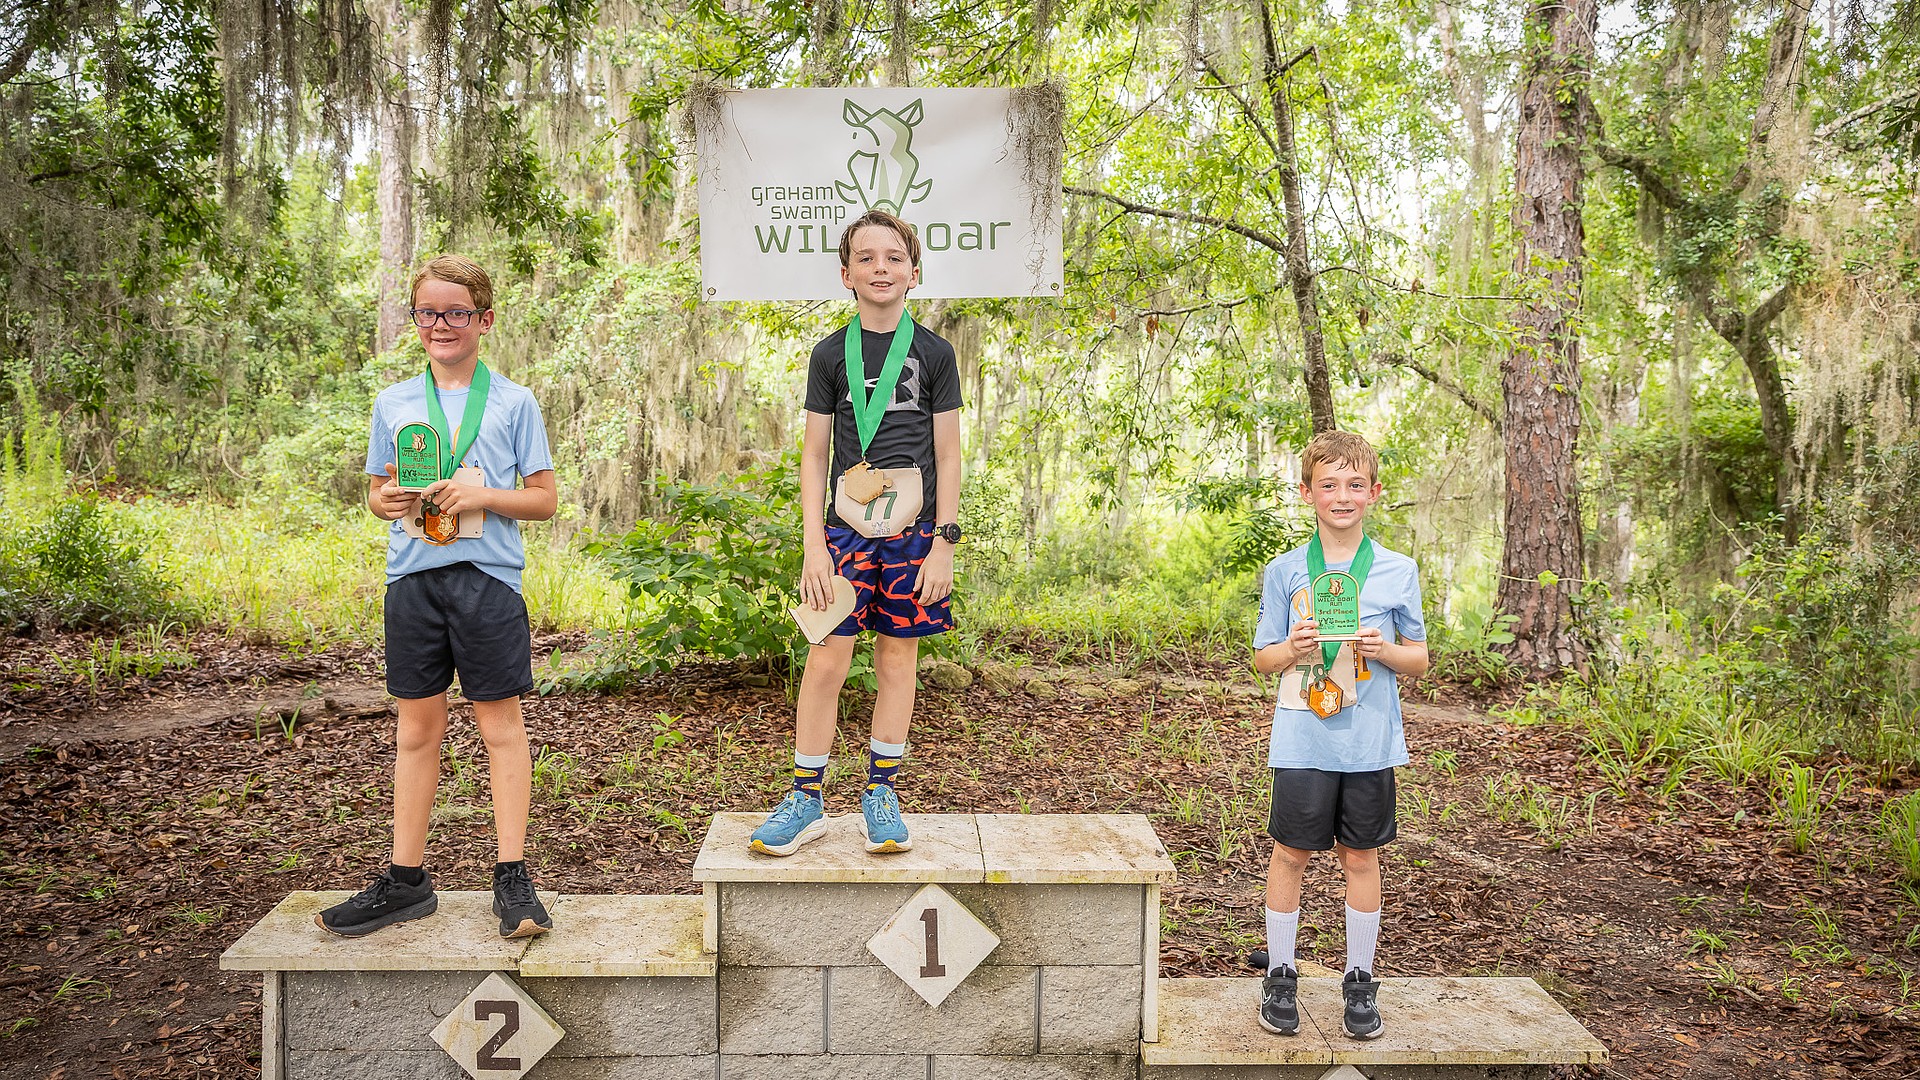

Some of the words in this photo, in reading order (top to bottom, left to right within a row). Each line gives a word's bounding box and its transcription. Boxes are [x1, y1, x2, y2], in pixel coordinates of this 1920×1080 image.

[754, 224, 841, 254] WIL
[911, 221, 1012, 252] oar
[771, 204, 846, 225] swamp
[919, 908, 946, 978] 1
[473, 1000, 521, 1070] 2
